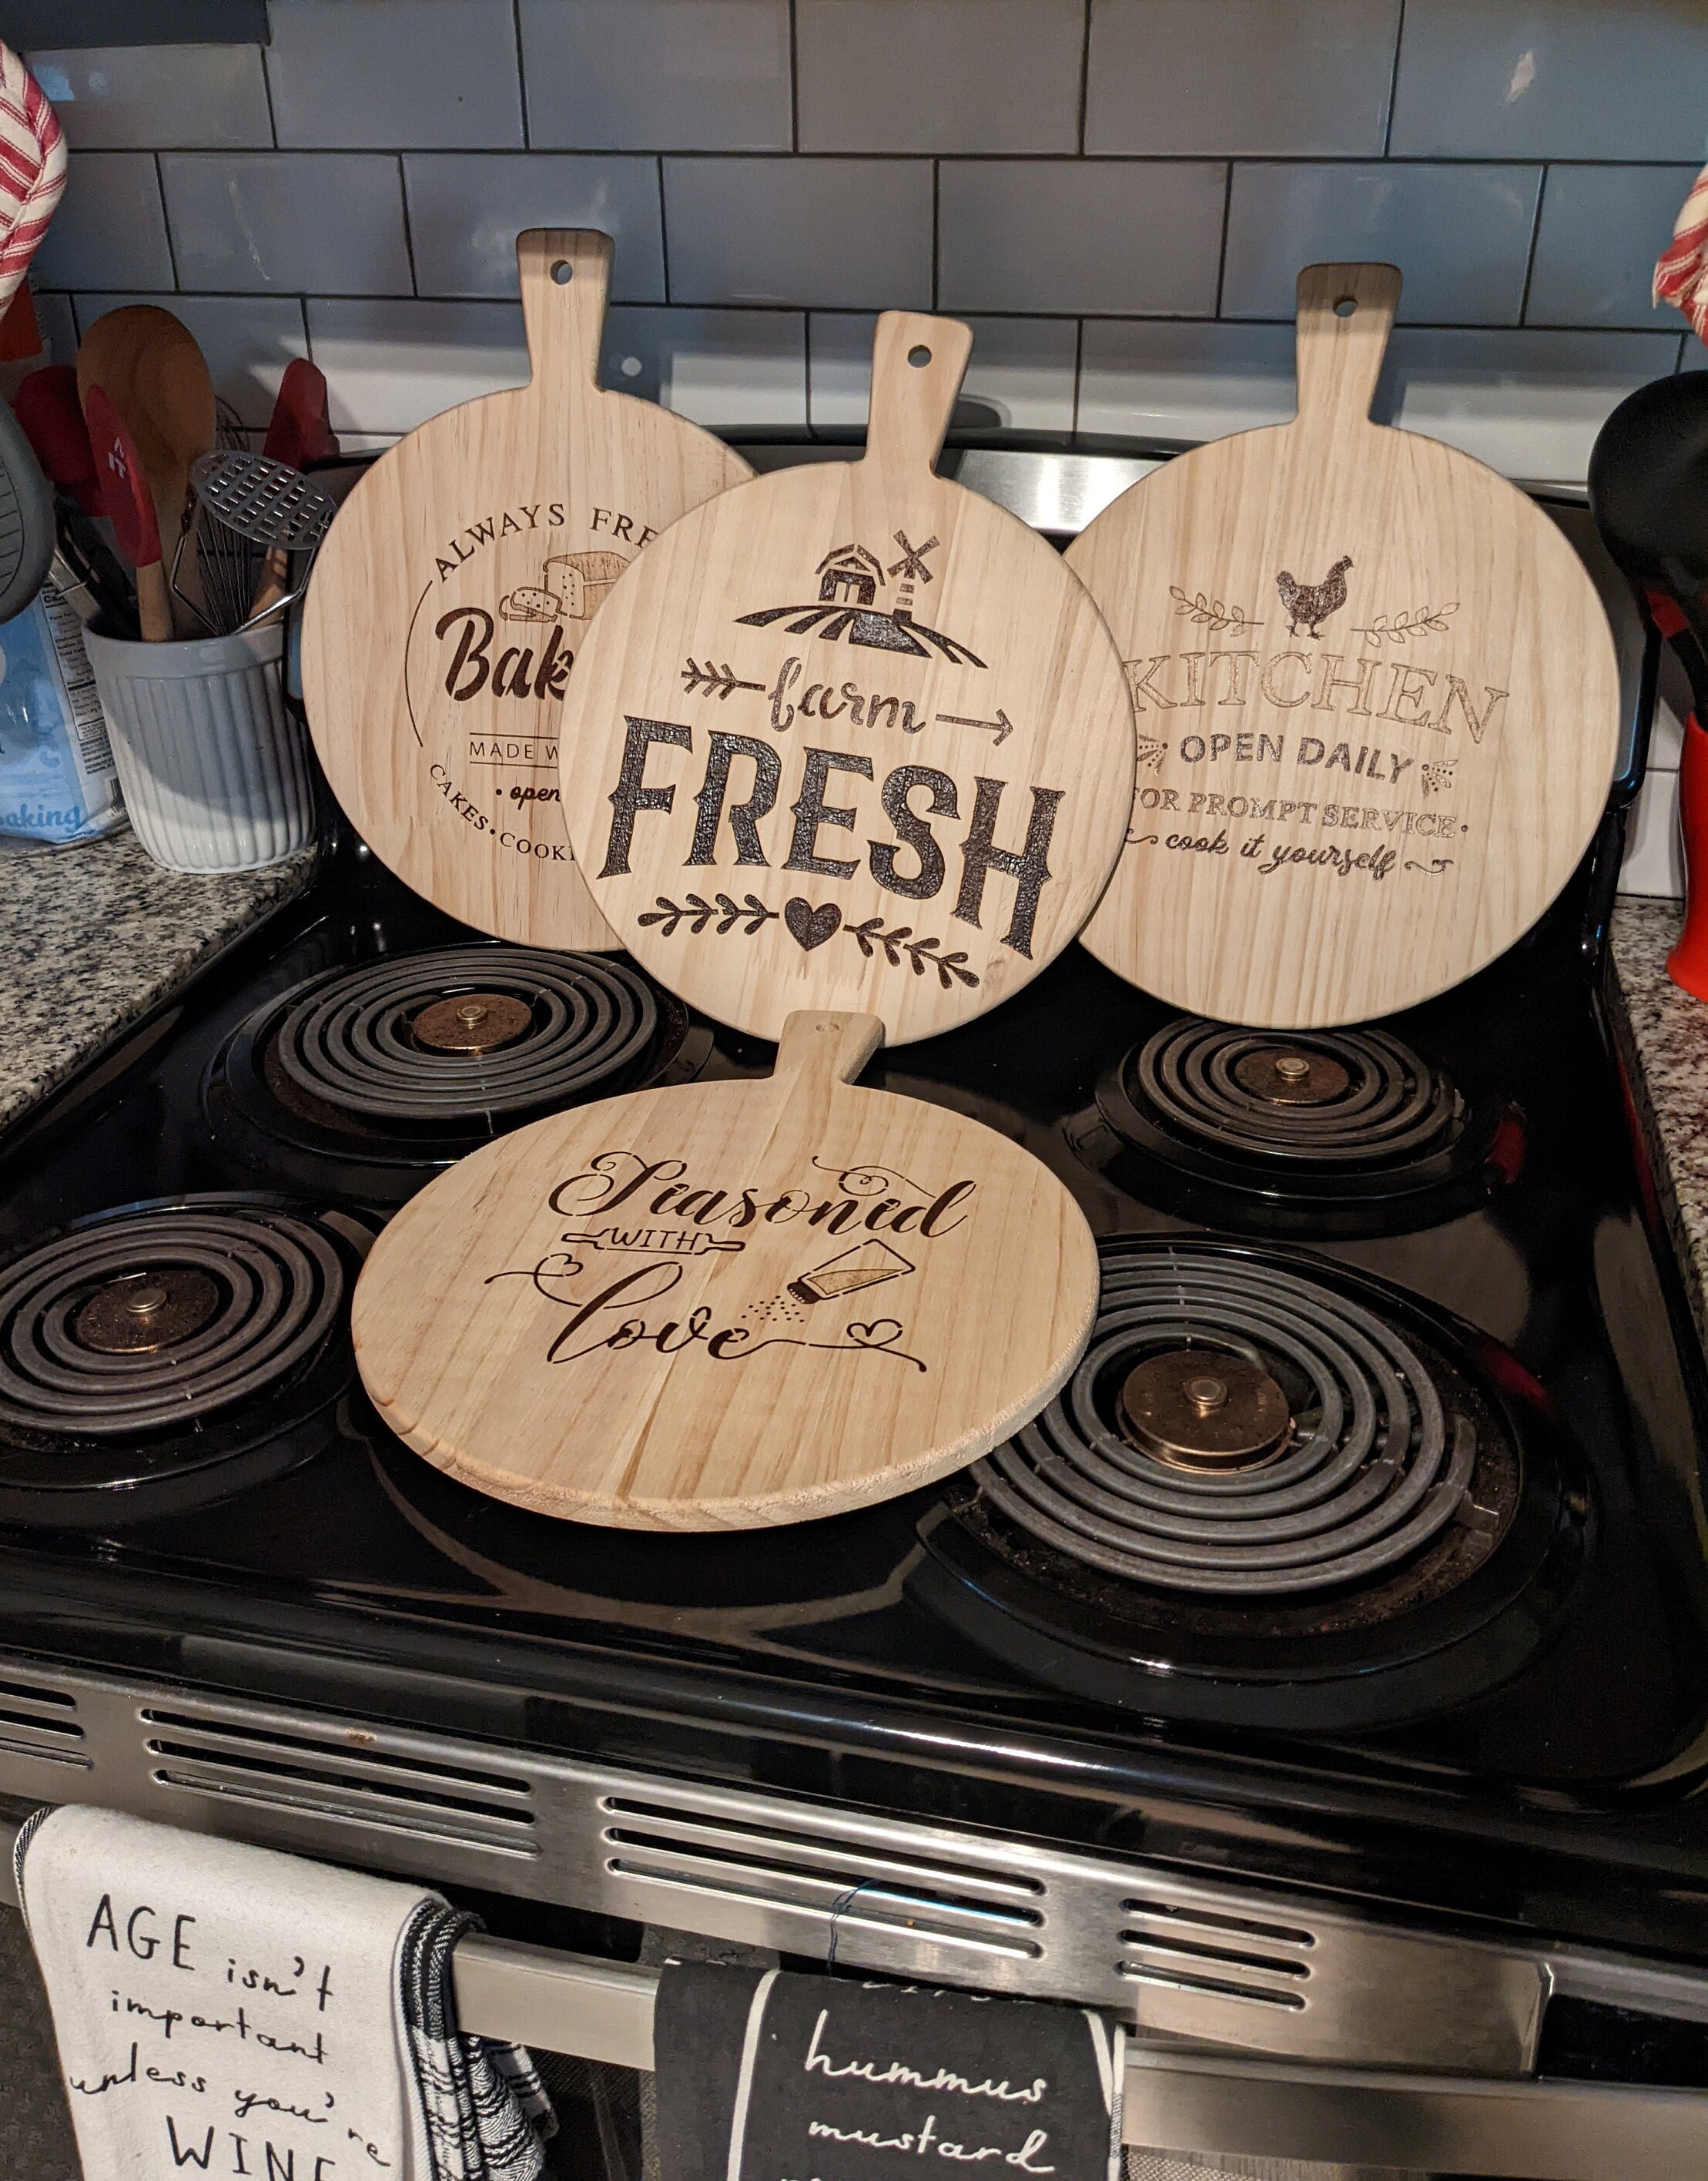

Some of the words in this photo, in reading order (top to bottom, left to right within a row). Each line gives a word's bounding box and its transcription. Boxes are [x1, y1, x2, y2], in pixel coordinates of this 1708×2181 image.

[433, 503, 565, 582] ALWAYS
[435, 607, 574, 702] Bak
[768, 656, 926, 733] farm
[1122, 650, 1509, 745] KITCHEN
[470, 742, 534, 759] MADE
[1179, 733, 1284, 763] OPEN
[1297, 737, 1415, 784] DAILY
[430, 764, 489, 831] CAKES
[510, 786, 561, 810] open
[1187, 792, 1318, 825] PROMPT
[1321, 804, 1457, 838] SERVICE
[596, 714, 1066, 961] FRESH
[1165, 829, 1230, 855] cook
[1239, 836, 1264, 858] it
[1257, 844, 1397, 880] yourself
[548, 1151, 976, 1238] Seasoned
[610, 1227, 698, 1251] WITH
[547, 1261, 751, 1364] love
[86, 1893, 197, 1971] AGE
[227, 1955, 334, 2012] isn't
[111, 1989, 330, 2064] important
[805, 2008, 1049, 2103] hummus
[70, 2042, 207, 2095] unless
[809, 2115, 1055, 2173] mustard
